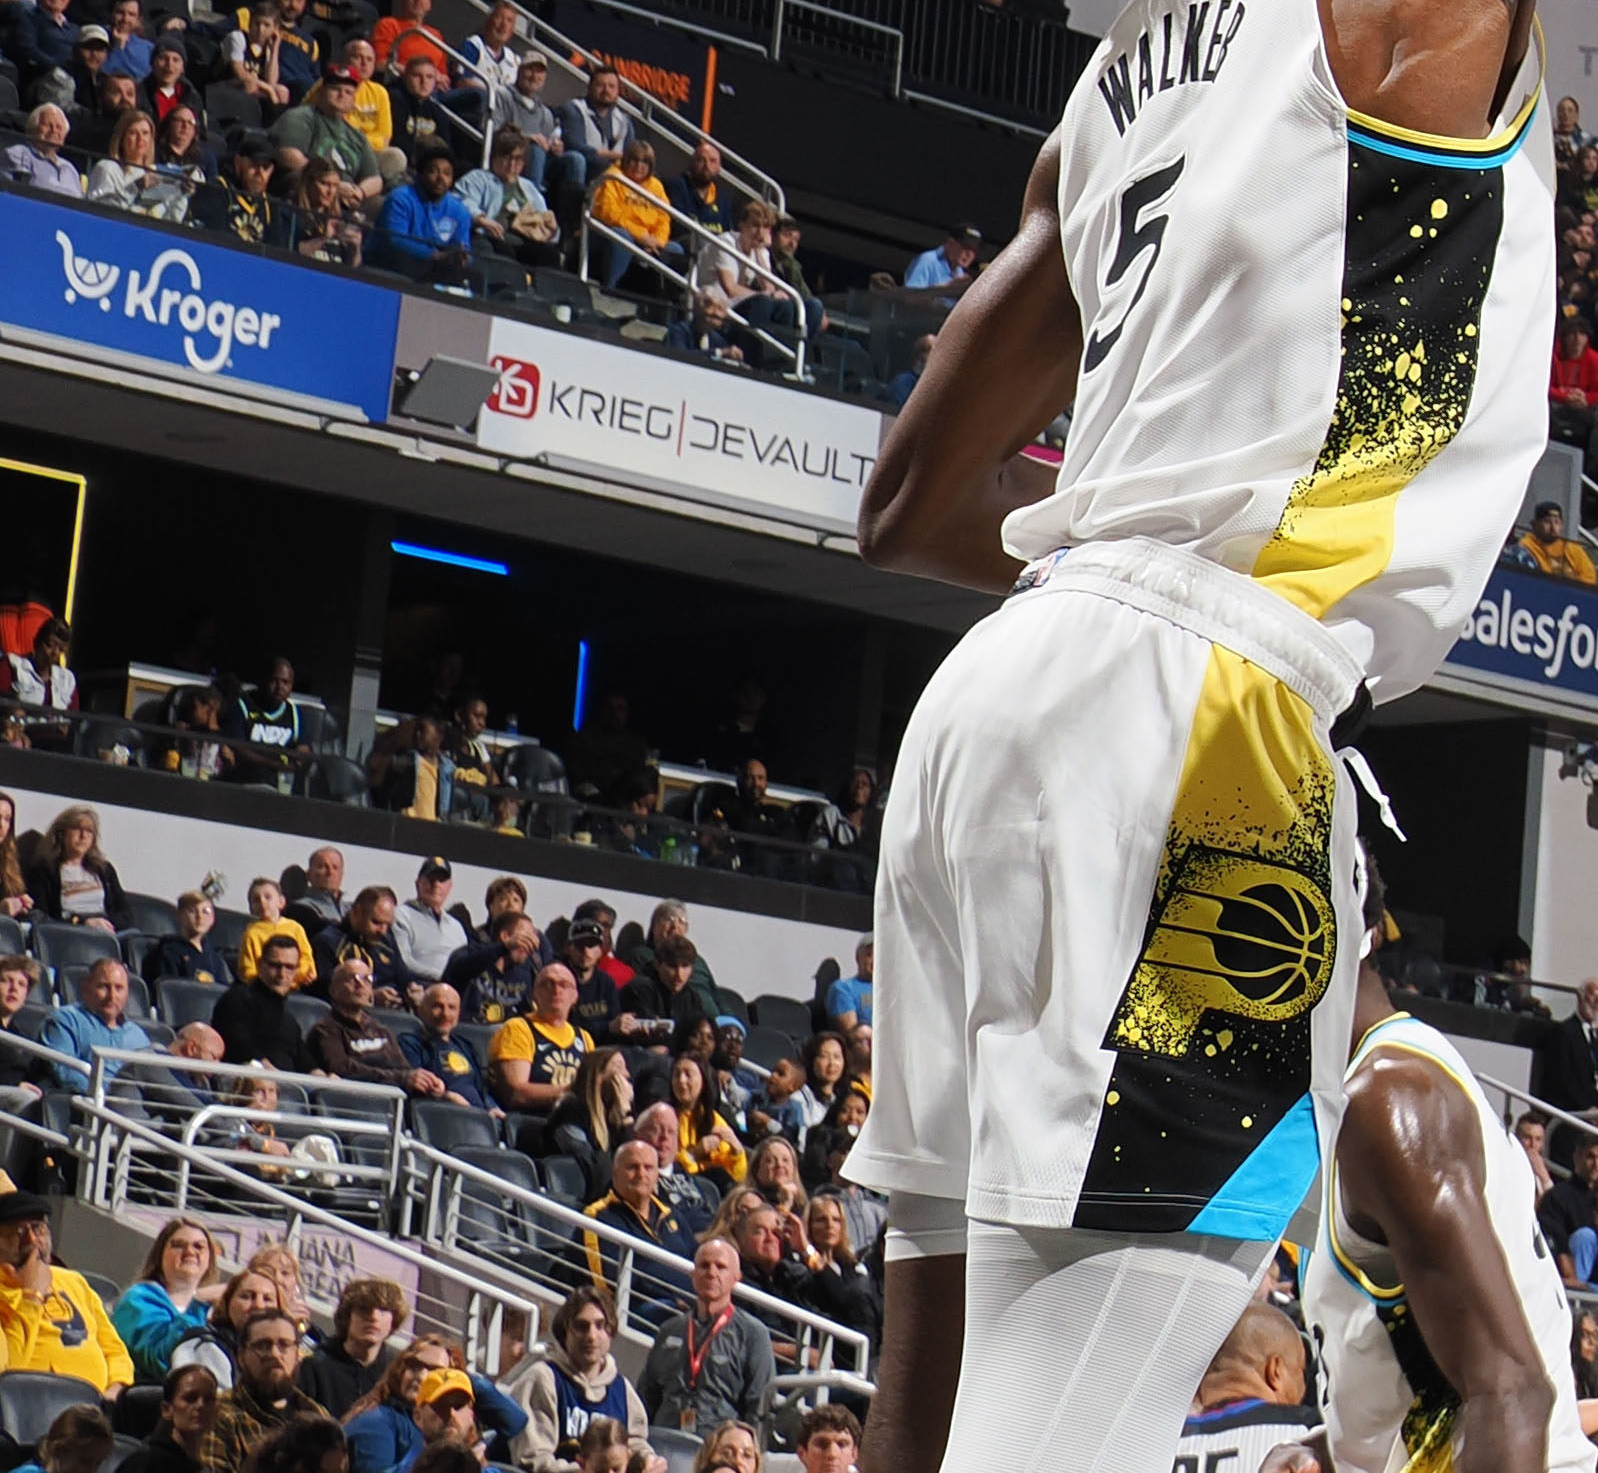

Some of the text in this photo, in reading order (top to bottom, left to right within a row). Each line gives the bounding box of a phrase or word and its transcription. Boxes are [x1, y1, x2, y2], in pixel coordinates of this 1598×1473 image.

[124, 248, 281, 374] Kroger
[1083, 154, 1187, 375] 5
[548, 380, 878, 488] KRIEG DEVAULT
